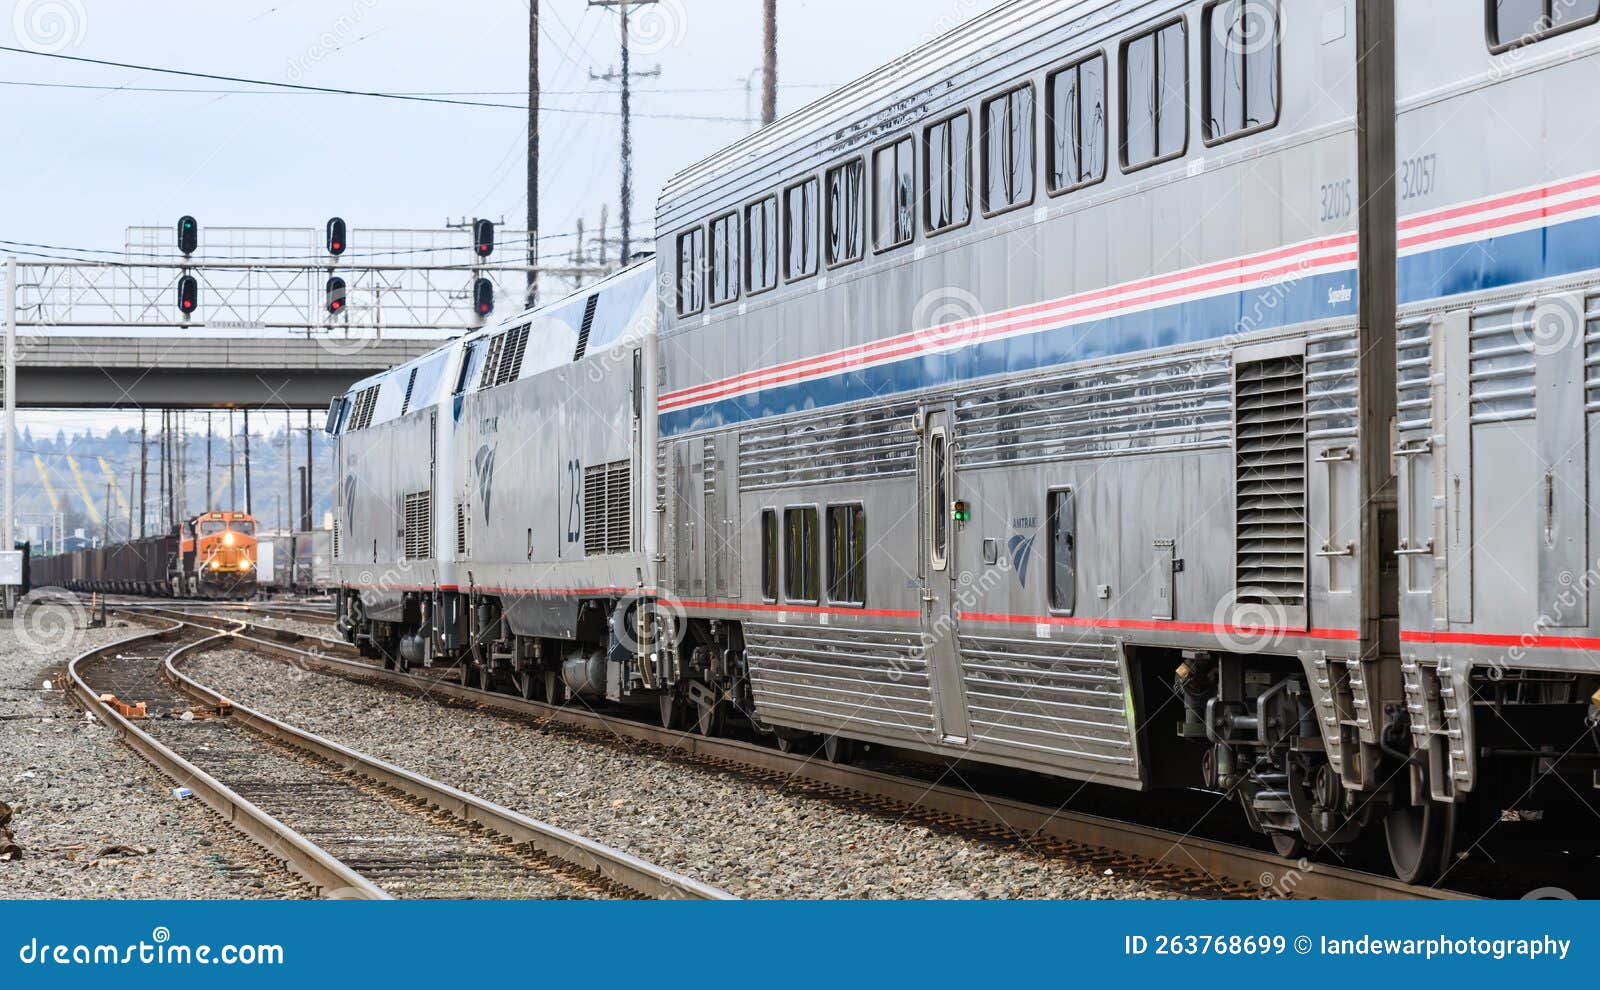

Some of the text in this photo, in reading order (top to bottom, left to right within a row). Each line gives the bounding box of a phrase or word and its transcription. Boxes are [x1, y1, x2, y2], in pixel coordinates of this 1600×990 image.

[1320, 178, 1351, 222] 32015
[1402, 152, 1437, 200] 32057
[567, 458, 581, 543] 23
